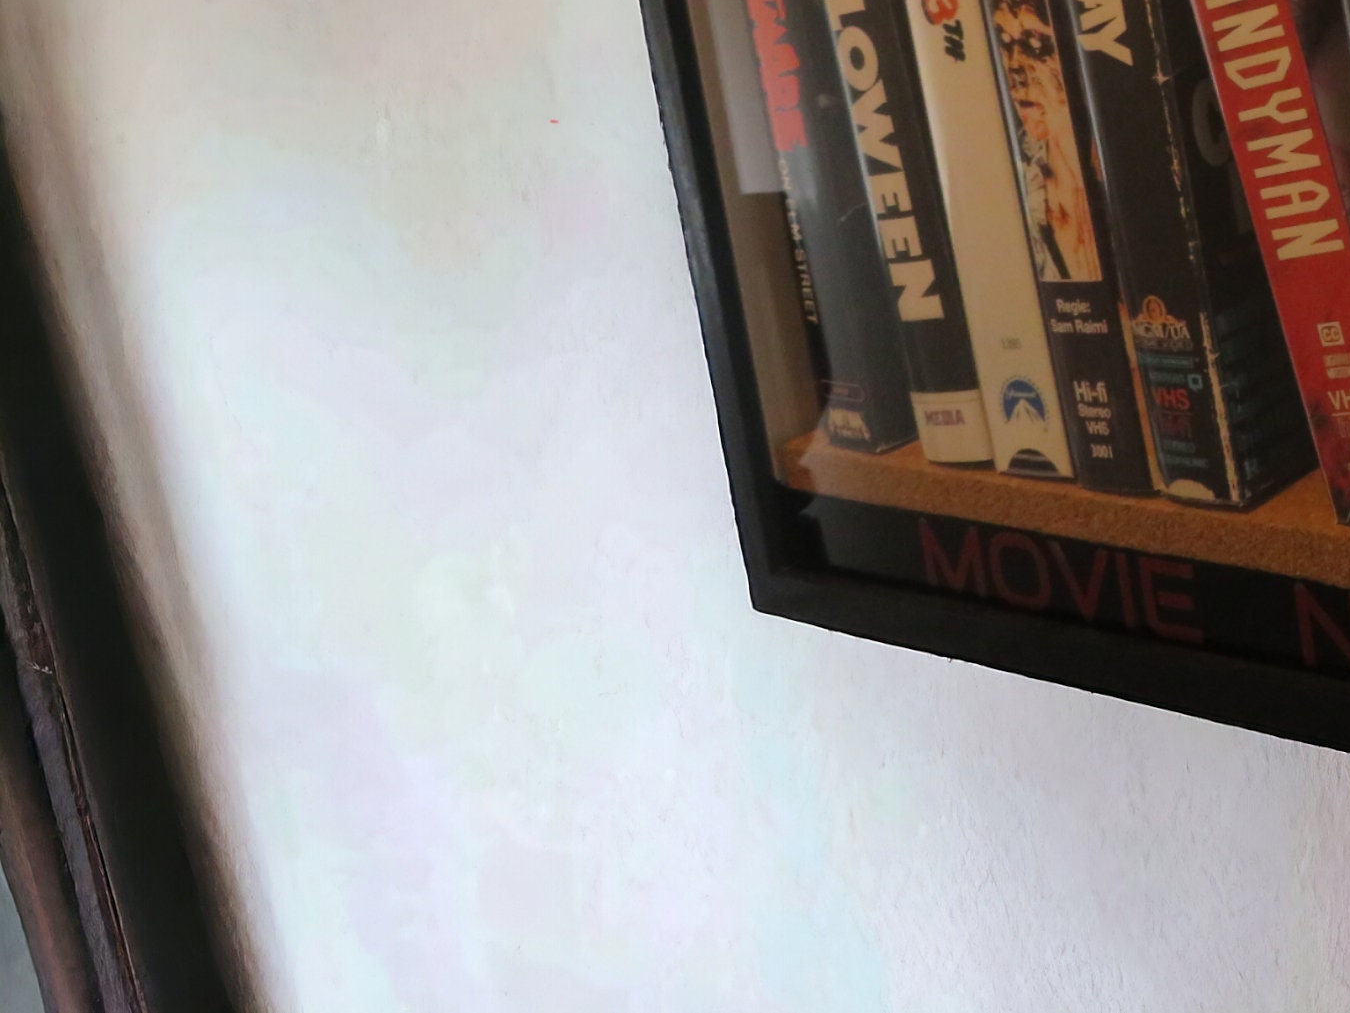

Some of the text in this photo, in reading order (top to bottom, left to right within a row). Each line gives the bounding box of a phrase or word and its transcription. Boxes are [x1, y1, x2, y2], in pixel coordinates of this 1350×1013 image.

[1056, 298, 1091, 316] Regie:
[1050, 318, 1108, 334] Sam Raimi
[1073, 380, 1108, 403] Hi-fi
[1154, 388, 1190, 410] VHS
[1086, 421, 1110, 436] VHS
[919, 517, 1201, 643] MOVIE
